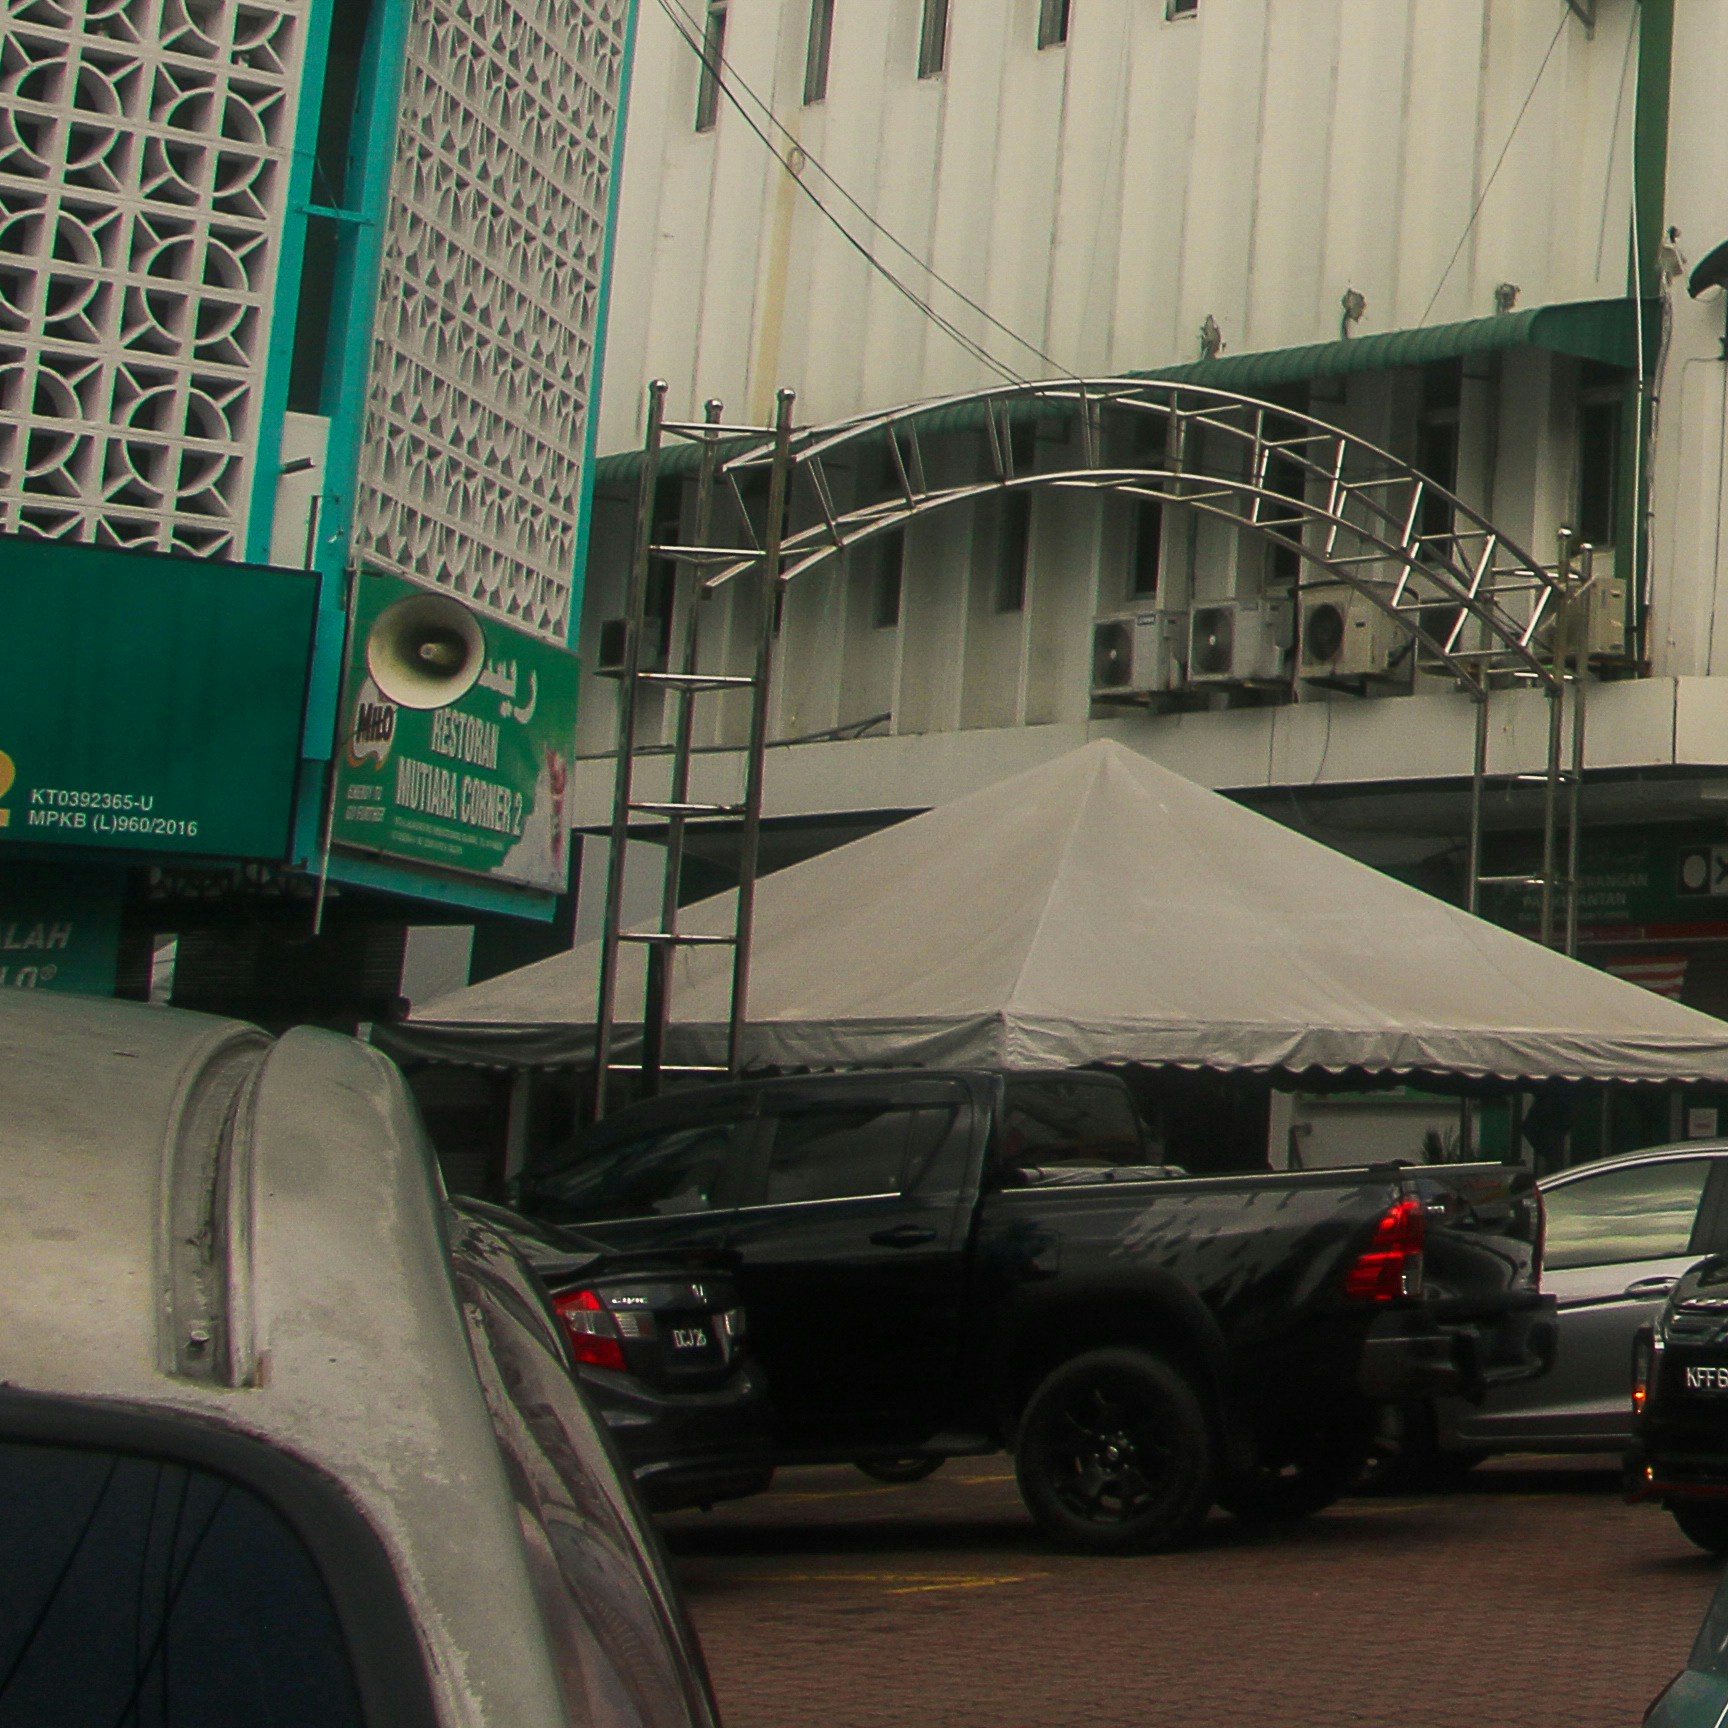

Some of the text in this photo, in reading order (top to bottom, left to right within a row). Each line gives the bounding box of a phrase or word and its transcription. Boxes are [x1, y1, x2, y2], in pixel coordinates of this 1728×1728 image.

[353, 702, 396, 744] MILO
[431, 707, 500, 770] RESTORAN
[30, 788, 154, 811] KT0392365-U
[395, 755, 457, 820] MUTIARA
[460, 774, 511, 834] CORNER
[511, 791, 524, 836] 2
[29, 809, 199, 837] MPKB (L)960/2016
